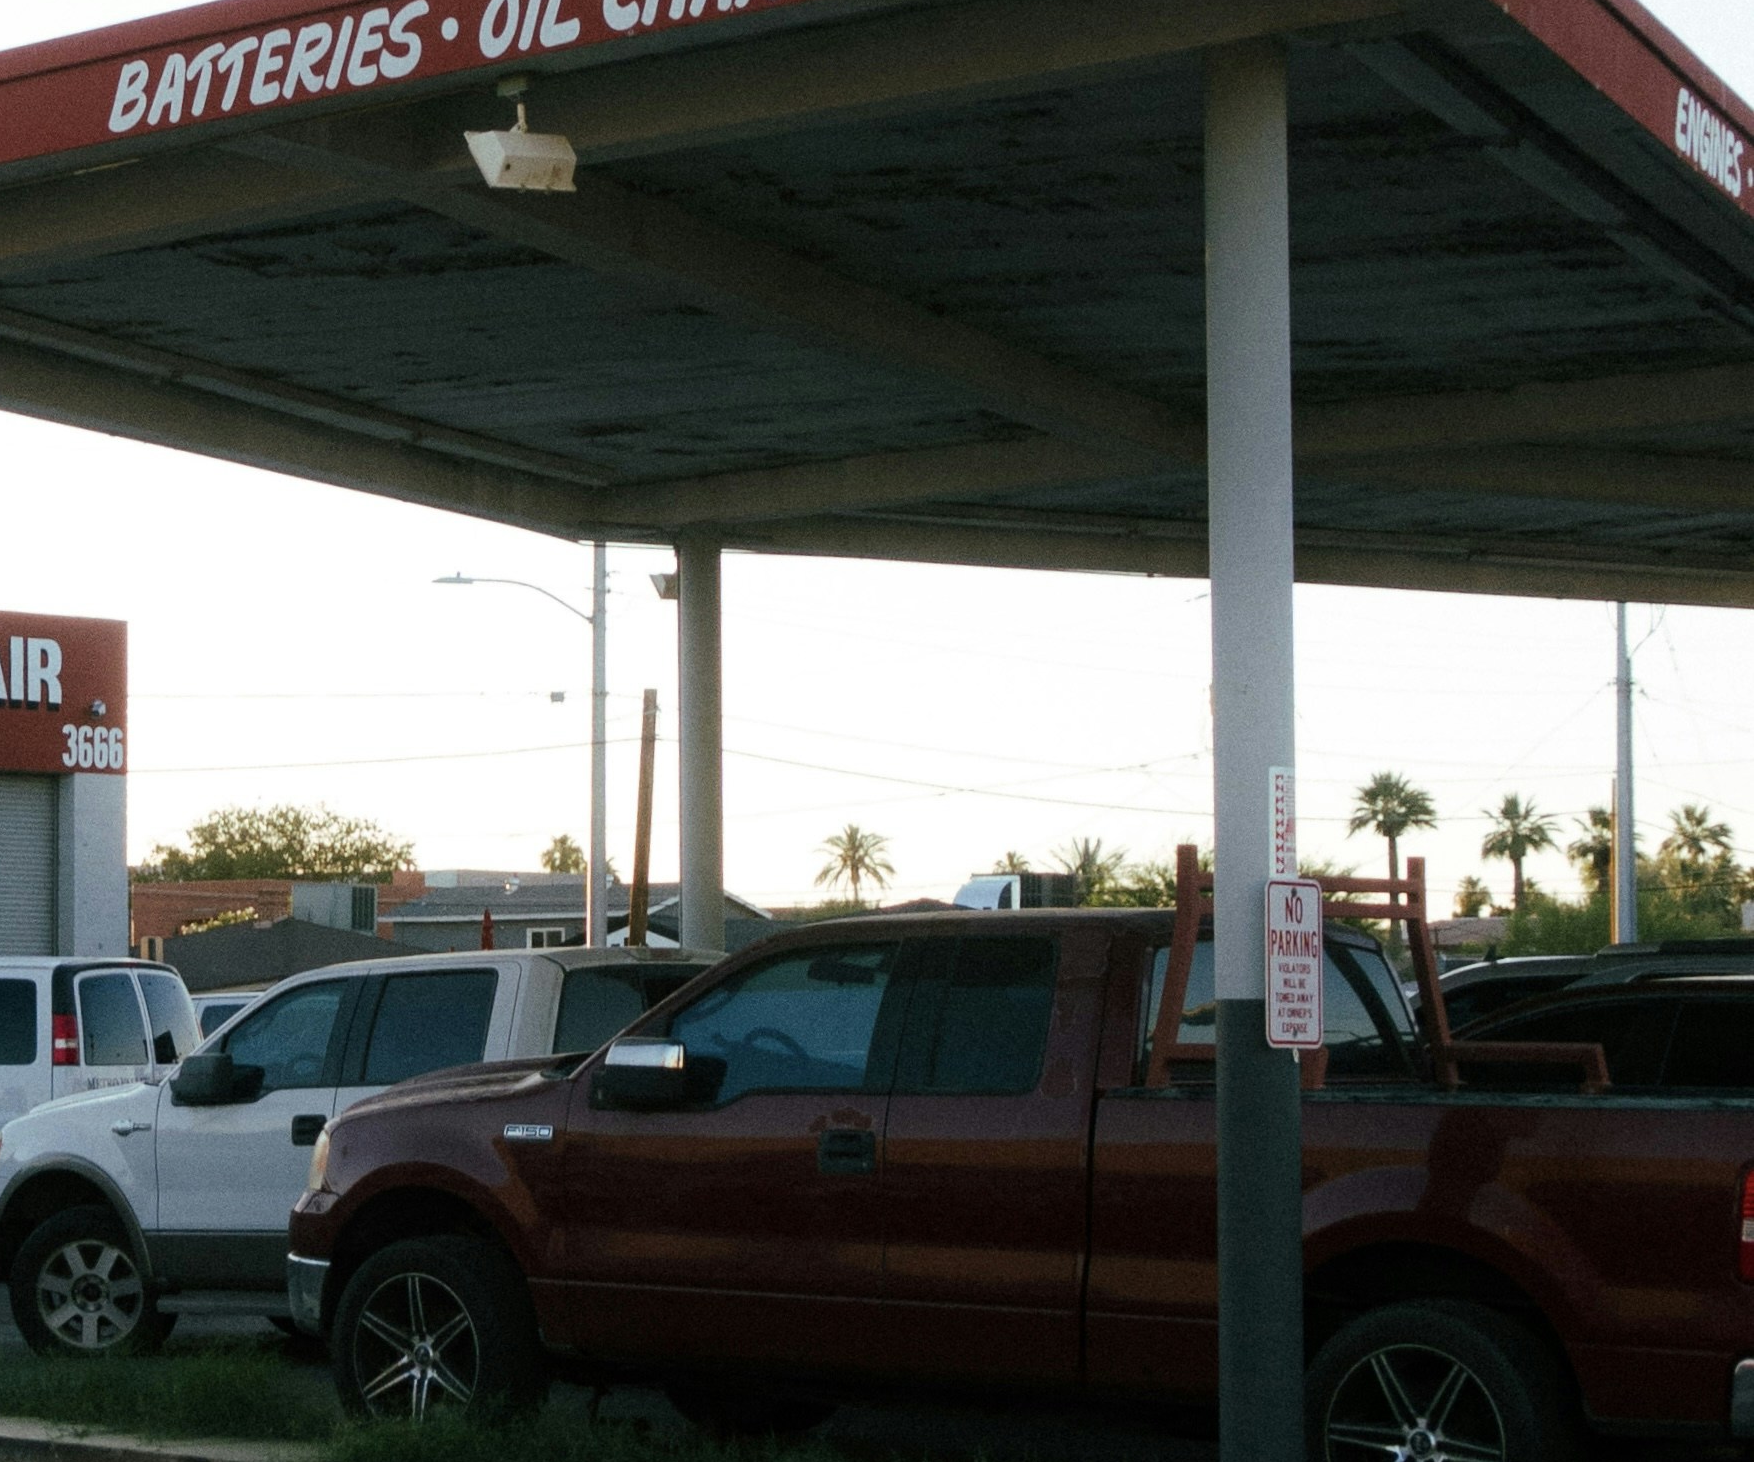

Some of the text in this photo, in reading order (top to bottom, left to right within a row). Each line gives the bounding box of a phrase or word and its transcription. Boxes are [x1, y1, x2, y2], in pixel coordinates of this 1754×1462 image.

[108, 0, 429, 133] BATTERIES
[1675, 87, 1743, 198] ENGINES
[61, 724, 124, 770] 3666
[1285, 896, 1303, 924] NO
[1271, 929, 1318, 958] PARKING
